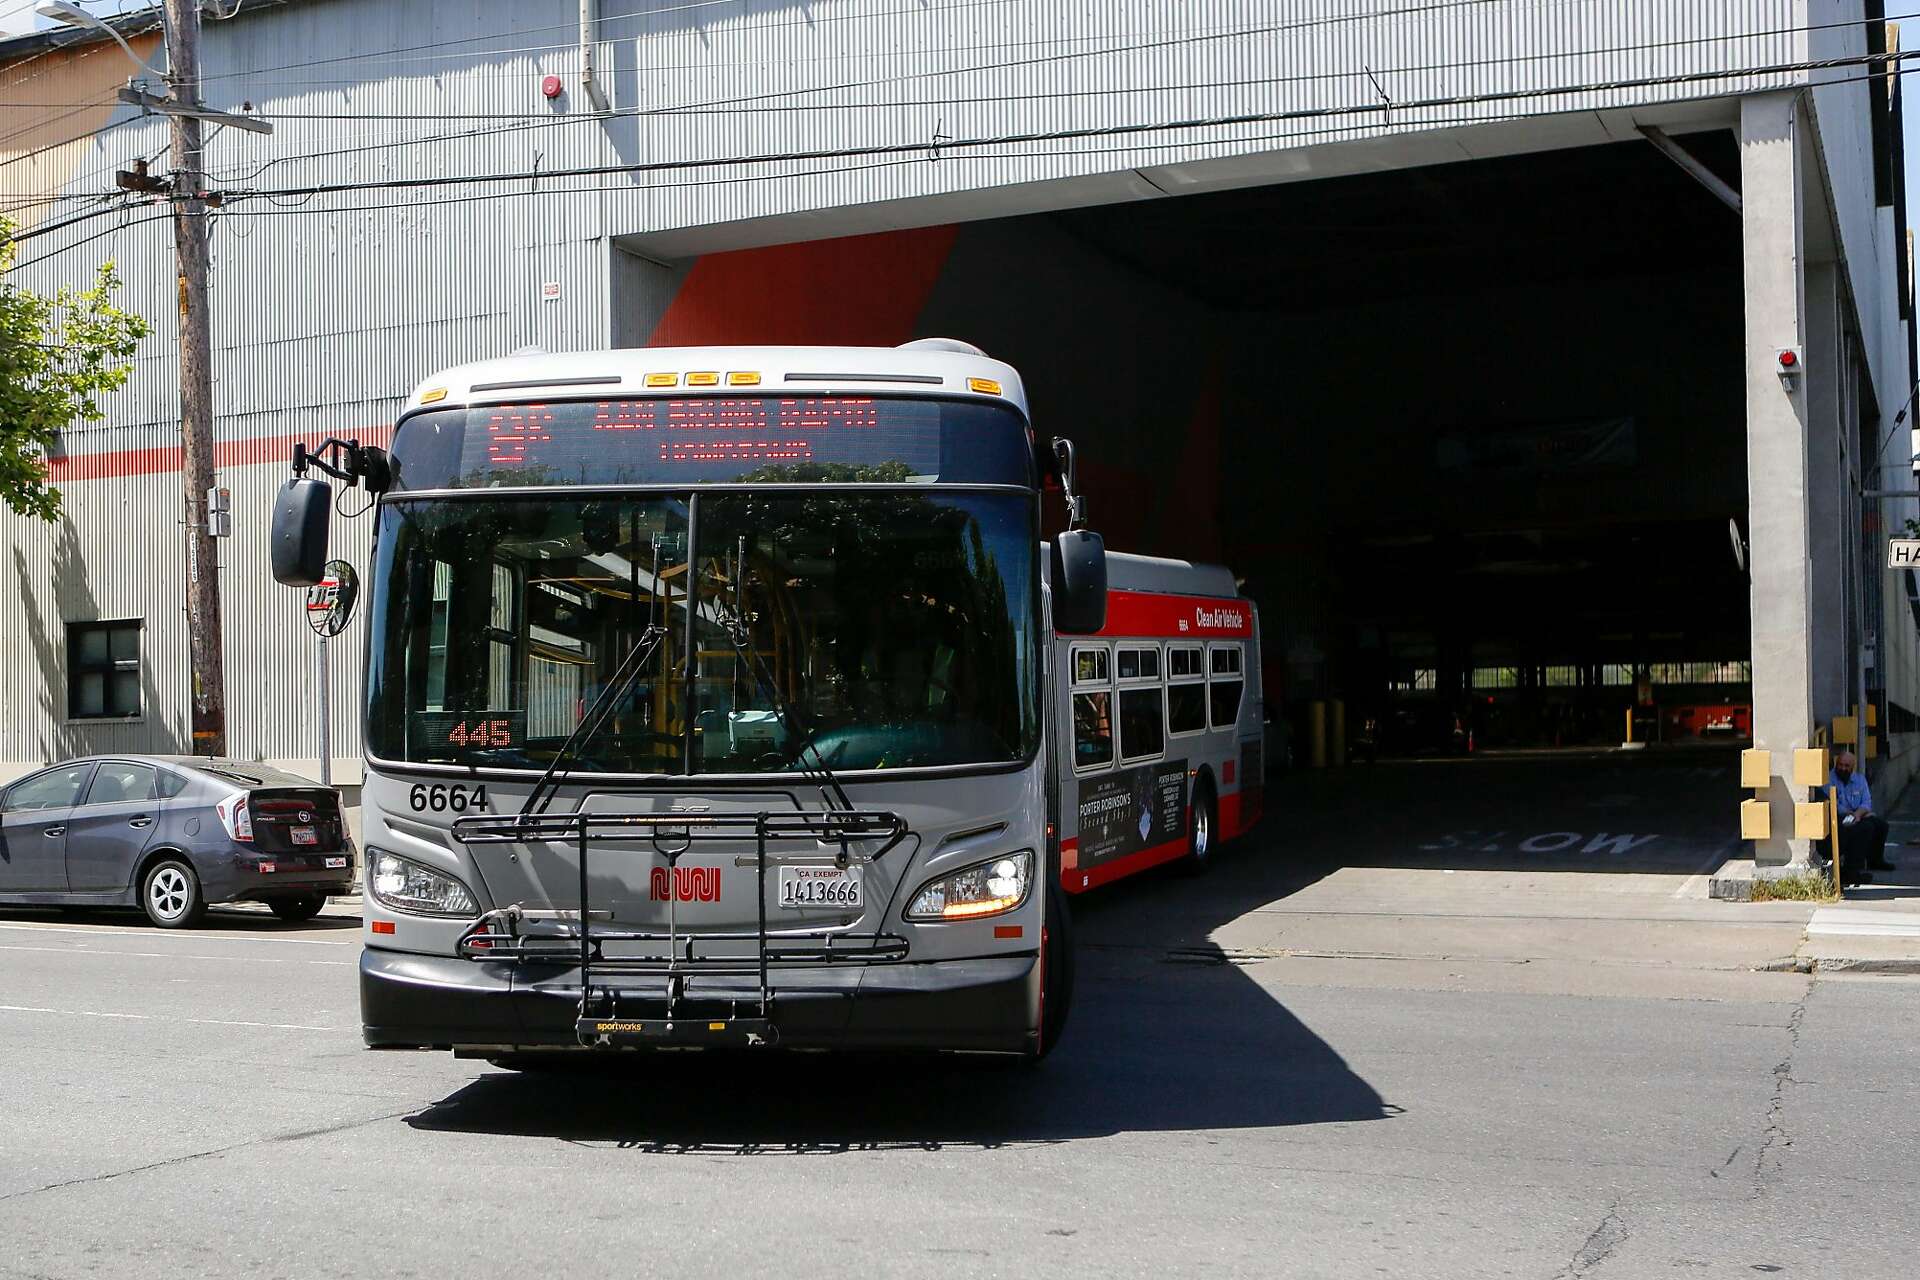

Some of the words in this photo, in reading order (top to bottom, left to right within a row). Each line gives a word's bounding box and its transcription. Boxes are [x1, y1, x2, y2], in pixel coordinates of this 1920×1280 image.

[1196, 607, 1214, 628] Clean
[1214, 608, 1222, 628] Air
[1222, 608, 1242, 629] Vehicle
[449, 720, 510, 746] 445
[410, 783, 488, 812] 6664
[1080, 799, 1101, 817] PORTER
[1101, 792, 1131, 811] ROBINSON'S
[799, 870, 810, 878] CA
[813, 870, 843, 878] EXEMPT
[784, 881, 858, 901] 1413666
[597, 1021, 642, 1031] sportworks
